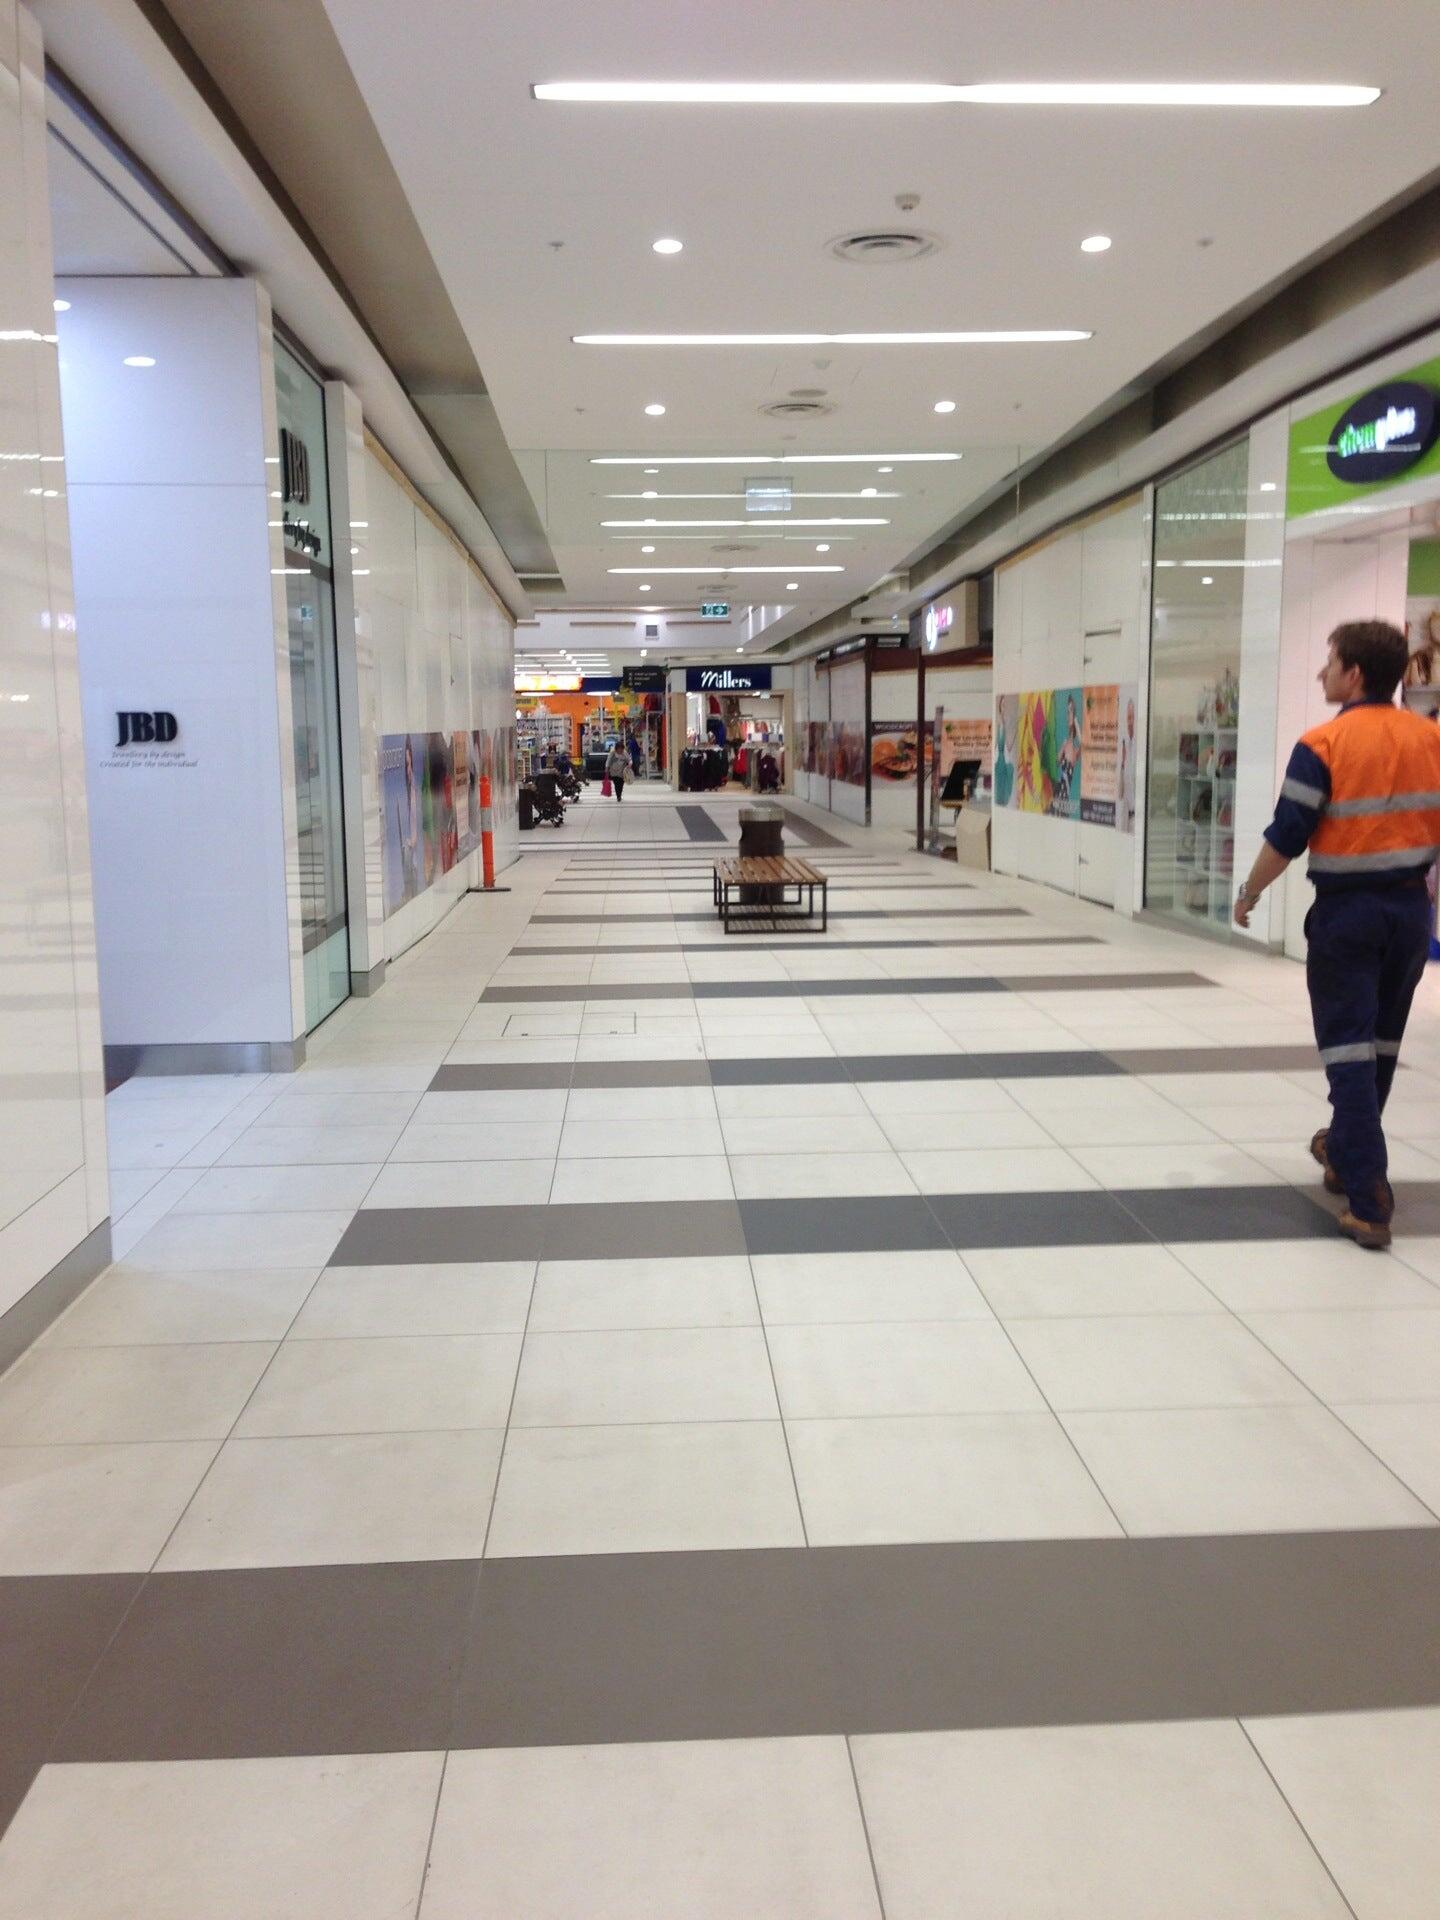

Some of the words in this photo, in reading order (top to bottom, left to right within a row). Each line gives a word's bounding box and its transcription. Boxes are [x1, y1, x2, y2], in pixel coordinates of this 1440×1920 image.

[701, 669, 752, 688] Millers
[115, 711, 178, 747] JBD
[99, 760, 129, 768] Created
[131, 760, 142, 769] for
[144, 760, 155, 768] the
